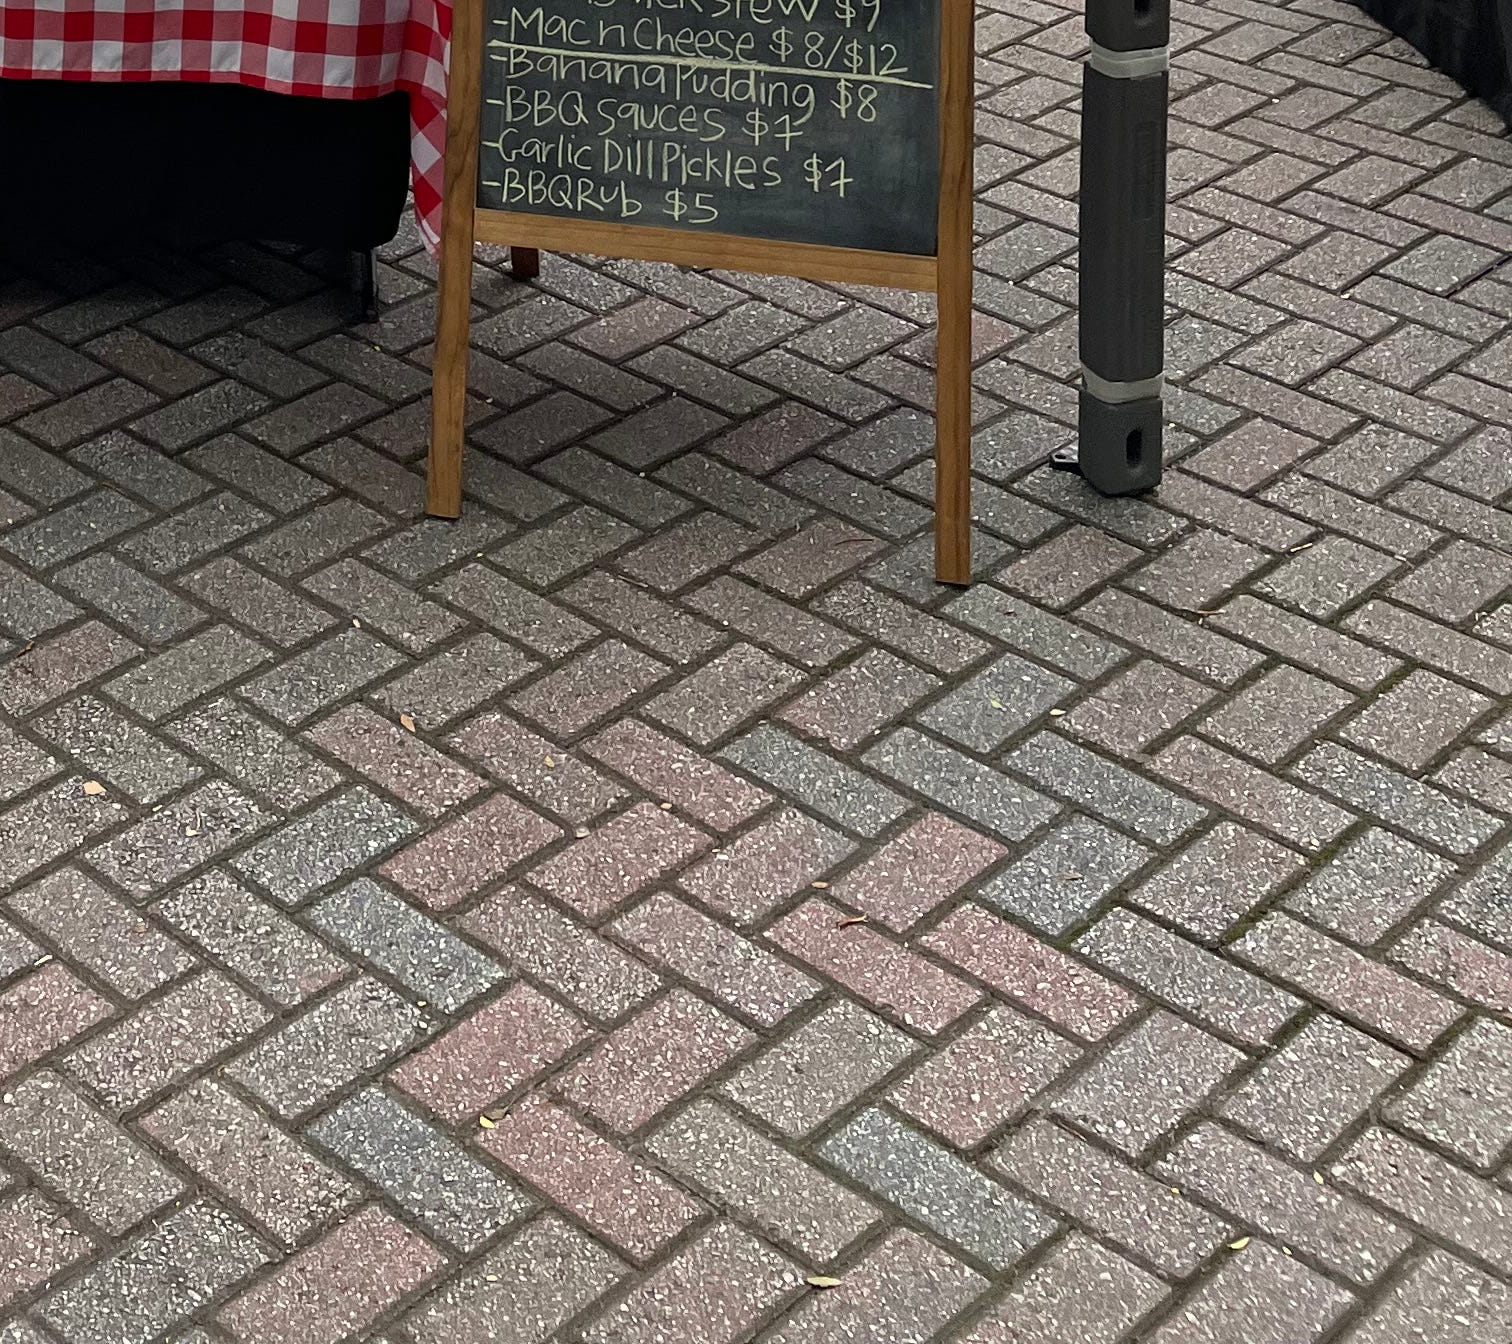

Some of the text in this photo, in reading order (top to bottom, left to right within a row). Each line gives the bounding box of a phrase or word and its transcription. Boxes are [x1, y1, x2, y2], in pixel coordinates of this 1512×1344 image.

[598, 14, 626, 49] n
[632, 17, 756, 64] Cheese
[675, 62, 817, 126] Pudding
[829, 78, 879, 123] $8
[741, 108, 804, 152] $7
[603, 136, 654, 180] Dill
[662, 142, 782, 190] Pickles
[803, 152, 854, 199] $7
[577, 177, 643, 218] Rub
[662, 187, 719, 224] $5
